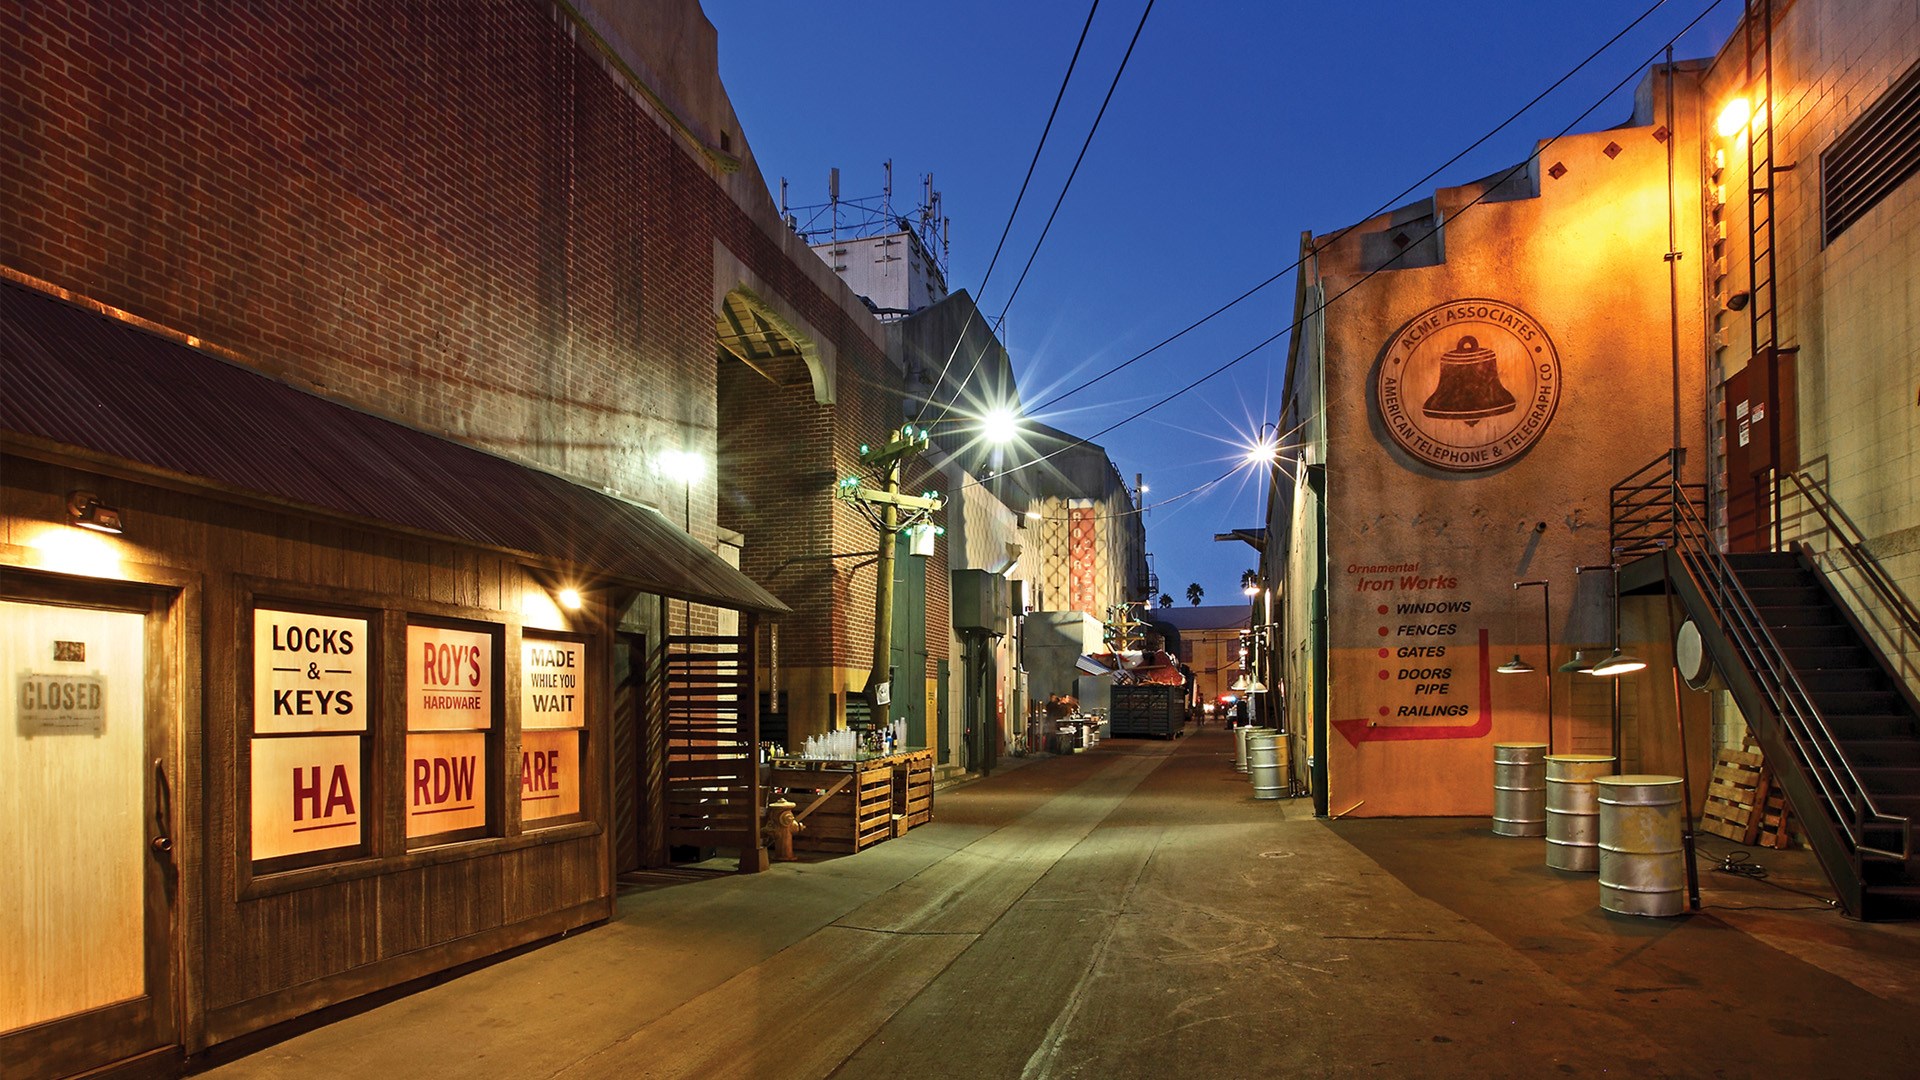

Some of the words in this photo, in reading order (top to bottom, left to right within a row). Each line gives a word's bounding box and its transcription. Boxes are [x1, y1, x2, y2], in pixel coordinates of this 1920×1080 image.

[1402, 315, 1441, 350] ACME
[1446, 306, 1536, 342] ASSOCIATES
[1385, 376, 1415, 441] AMERICAN
[1411, 435, 1489, 463] TELEPHONE
[1492, 446, 1503, 457] &
[1503, 385, 1552, 452] TELEGRAPH
[1539, 363, 1552, 381] CO
[1347, 562, 1420, 574] Ornamental
[1357, 577, 1394, 592] Iron
[1400, 575, 1458, 591] Works
[1397, 601, 1472, 615] WINDOWS
[1397, 624, 1457, 636] FENCES
[272, 624, 354, 655] LOCKS
[531, 648, 575, 668] MADE
[1397, 646, 1446, 658] GATES
[307, 661, 321, 680] &
[424, 642, 481, 687] ROY'S
[531, 673, 557, 688] WHILE
[559, 674, 576, 688] YOU
[1397, 668, 1452, 680] DOORS
[22, 681, 102, 711] CLOSED
[1415, 683, 1449, 695] PIPE
[274, 689, 354, 715] KEYS
[424, 695, 481, 710] HARDWARE
[533, 694, 575, 712] WAIT
[1397, 705, 1469, 717] RAILINGS
[293, 764, 356, 821] HA
[413, 756, 476, 806] RDW
[521, 750, 559, 794] ARE
